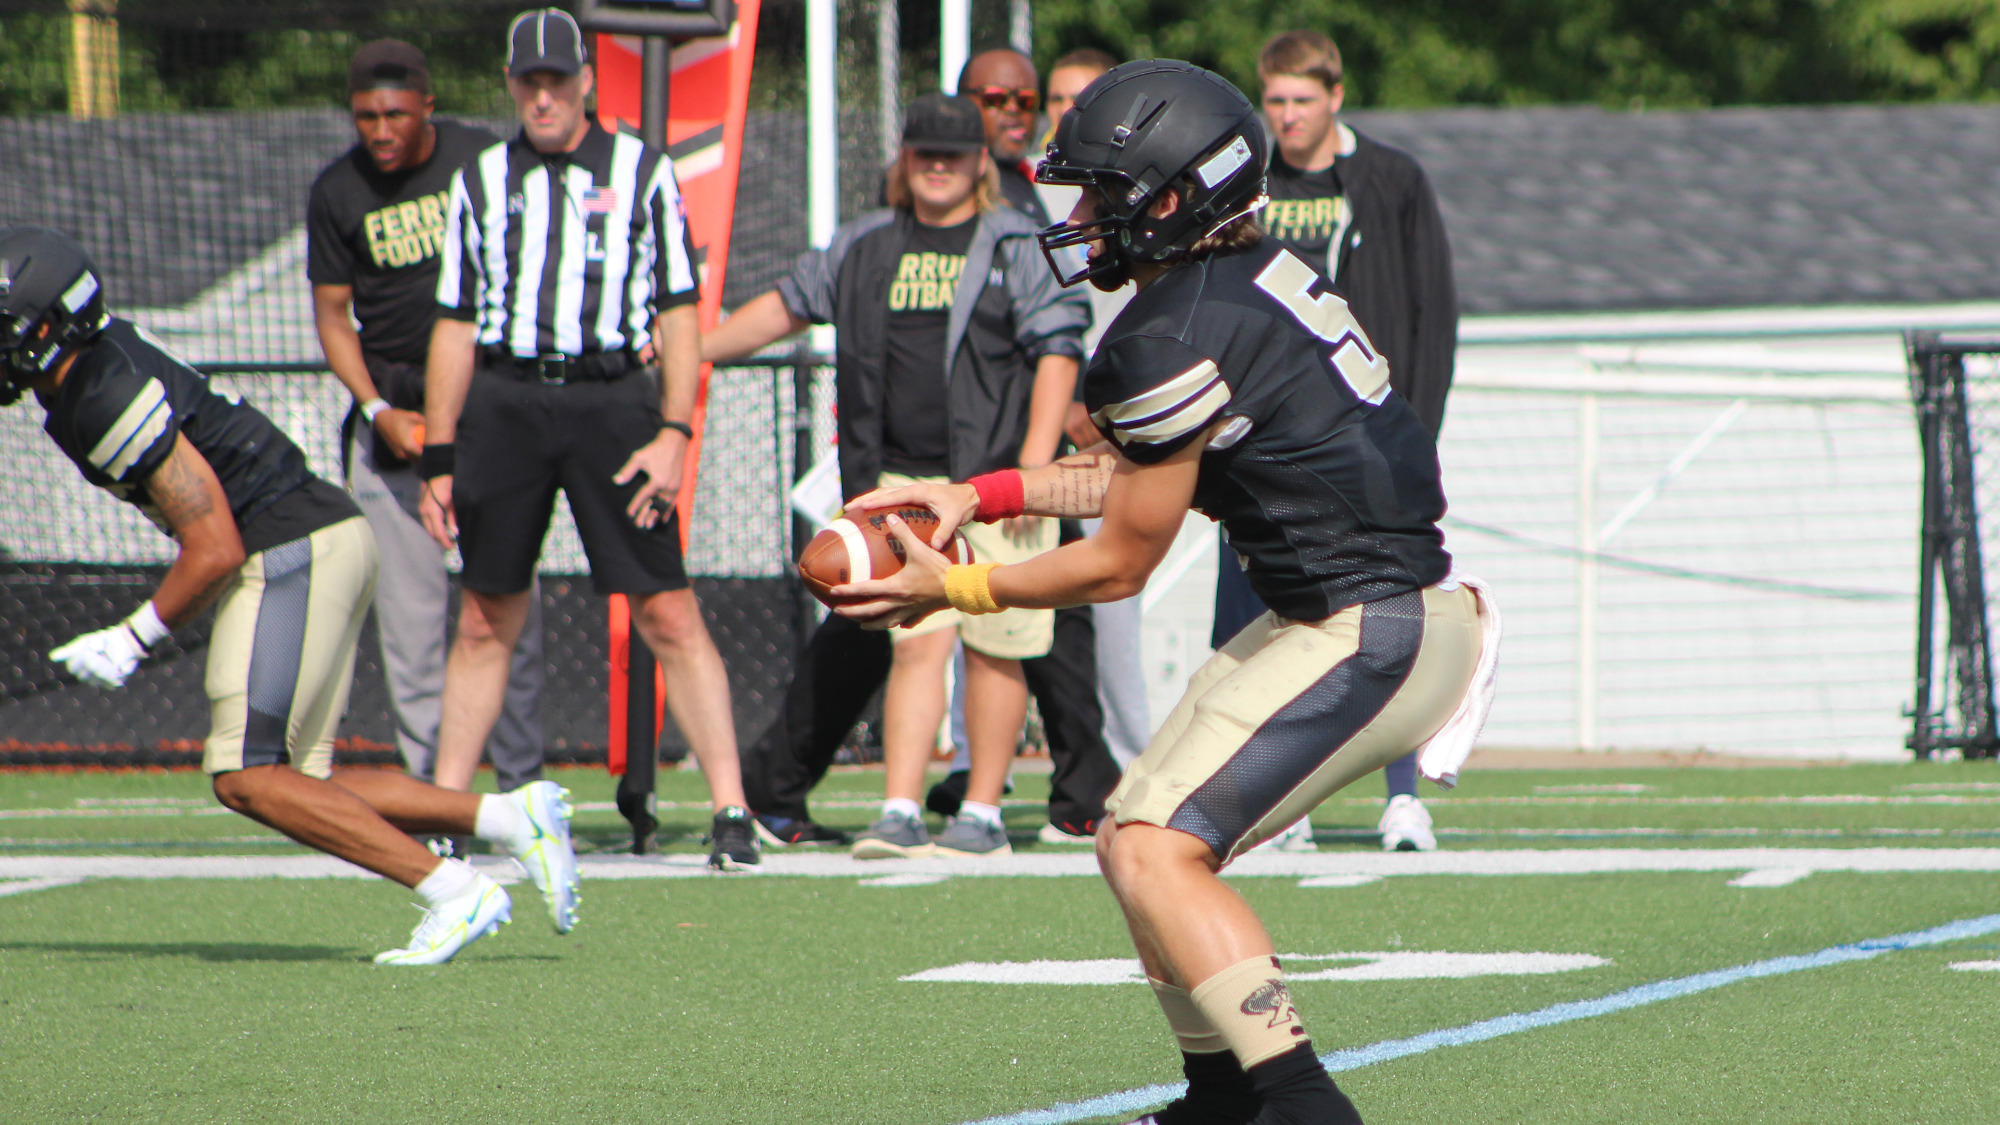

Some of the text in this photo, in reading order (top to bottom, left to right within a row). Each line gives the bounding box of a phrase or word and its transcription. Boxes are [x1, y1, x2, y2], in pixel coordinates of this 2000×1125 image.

[896, 251, 967, 281] RRU
[889, 279, 958, 312] OTBA
[1253, 247, 1393, 407] 5
